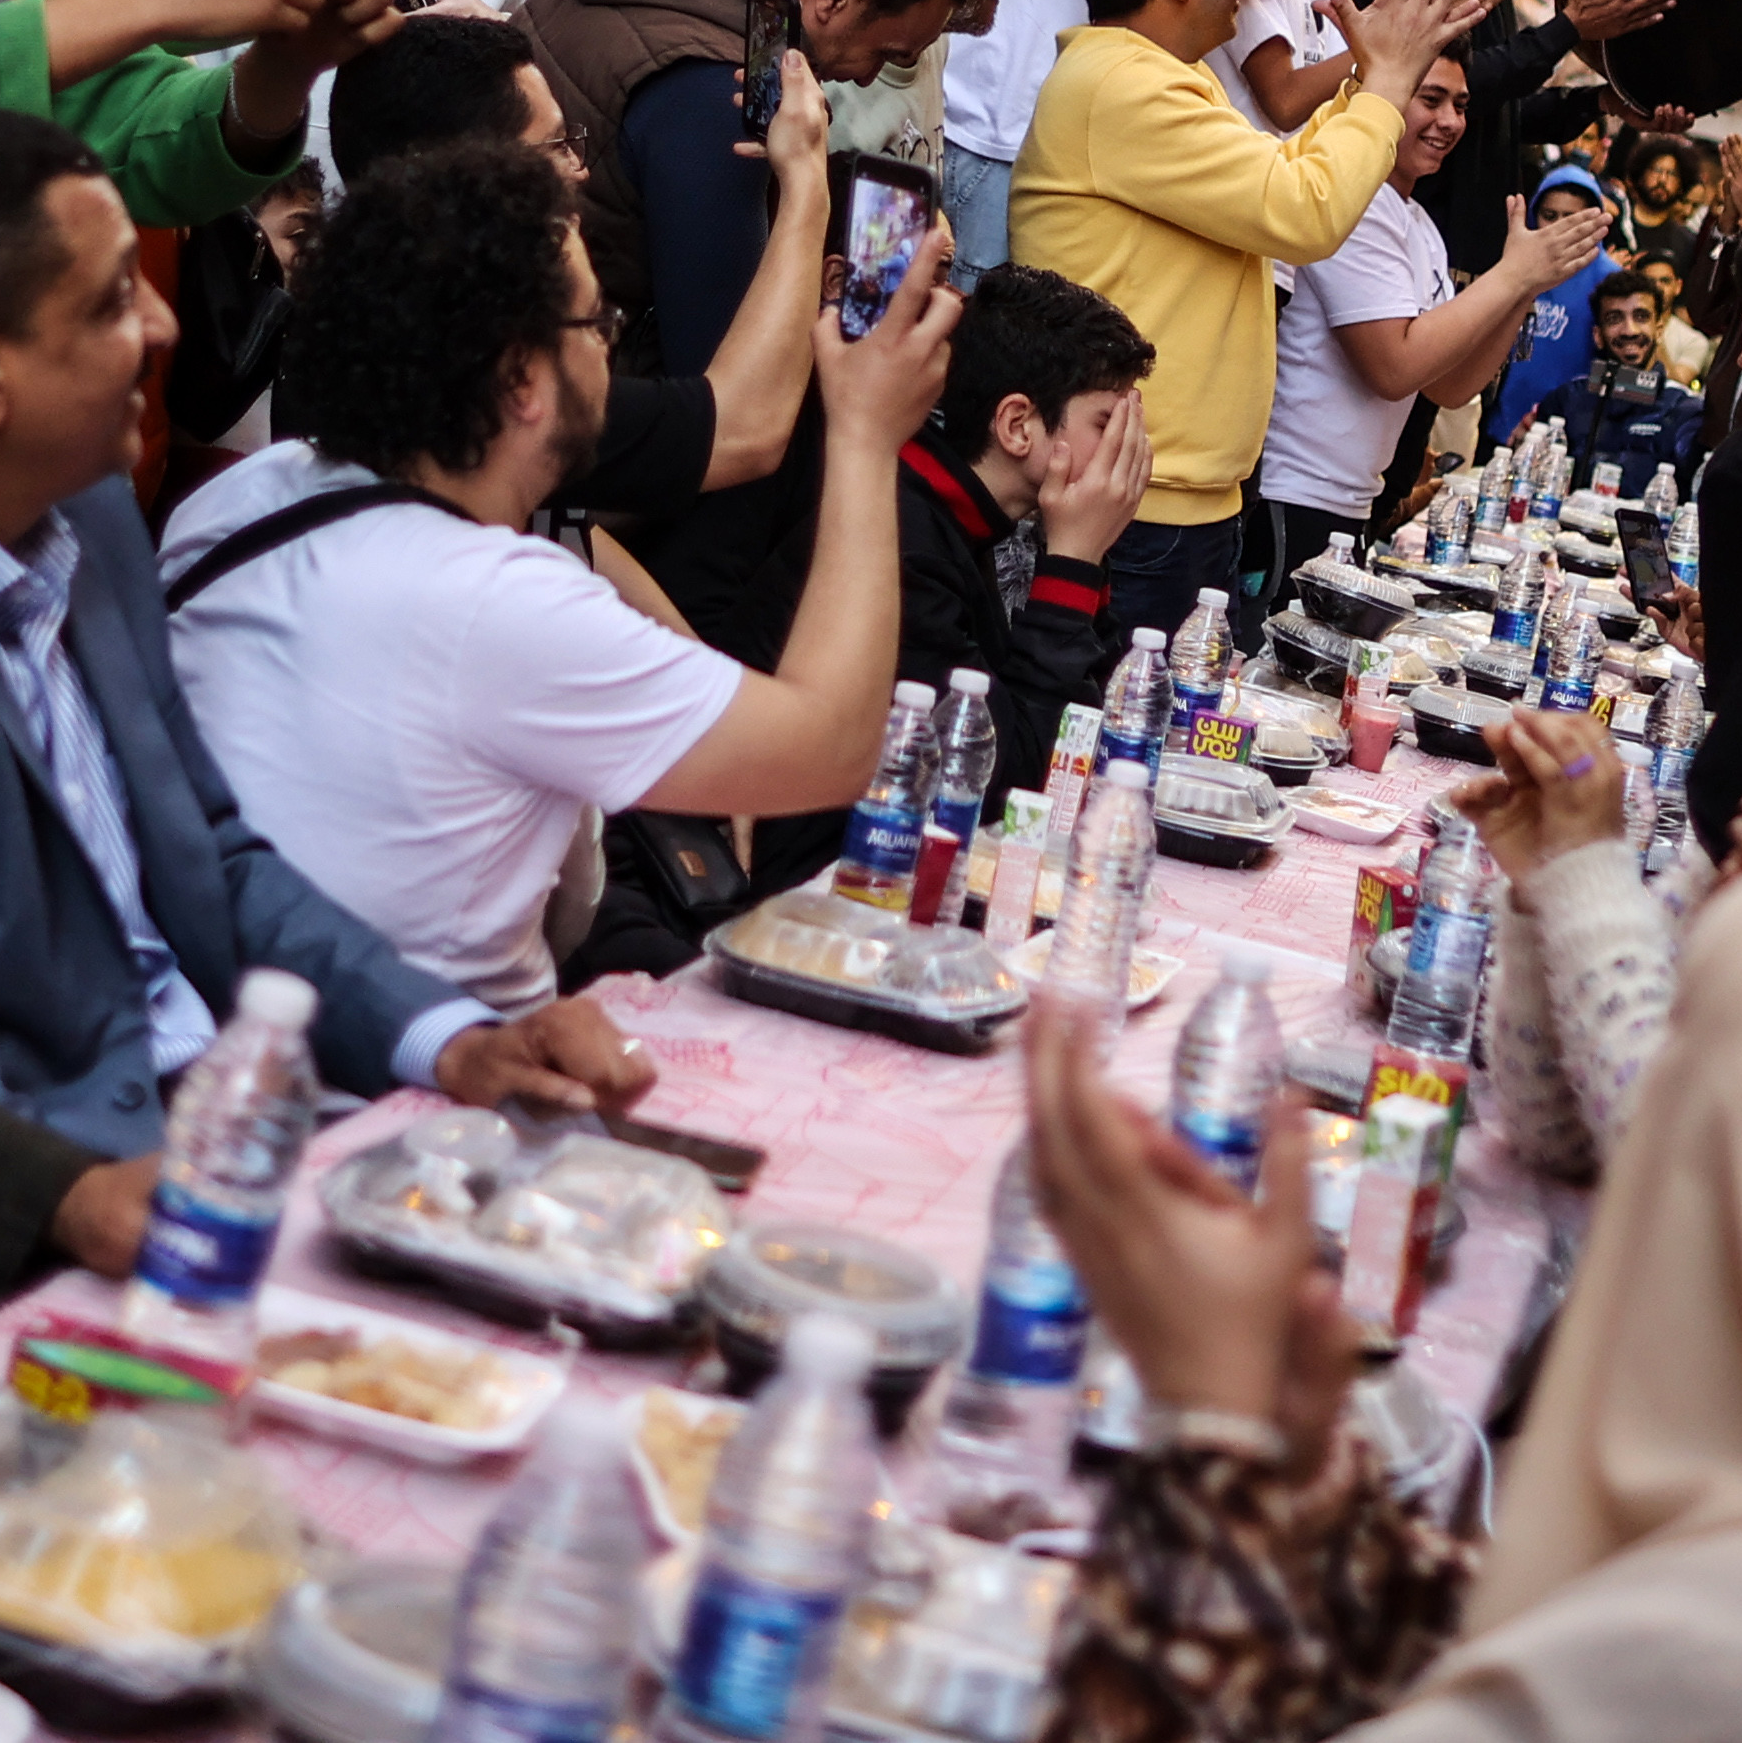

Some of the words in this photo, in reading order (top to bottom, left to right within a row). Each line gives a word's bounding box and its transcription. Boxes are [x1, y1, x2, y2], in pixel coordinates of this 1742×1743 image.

[1549, 690, 1589, 708] AQUAFIN
[1195, 716, 1243, 745] سن
[866, 827, 922, 850] AQUAFIN
